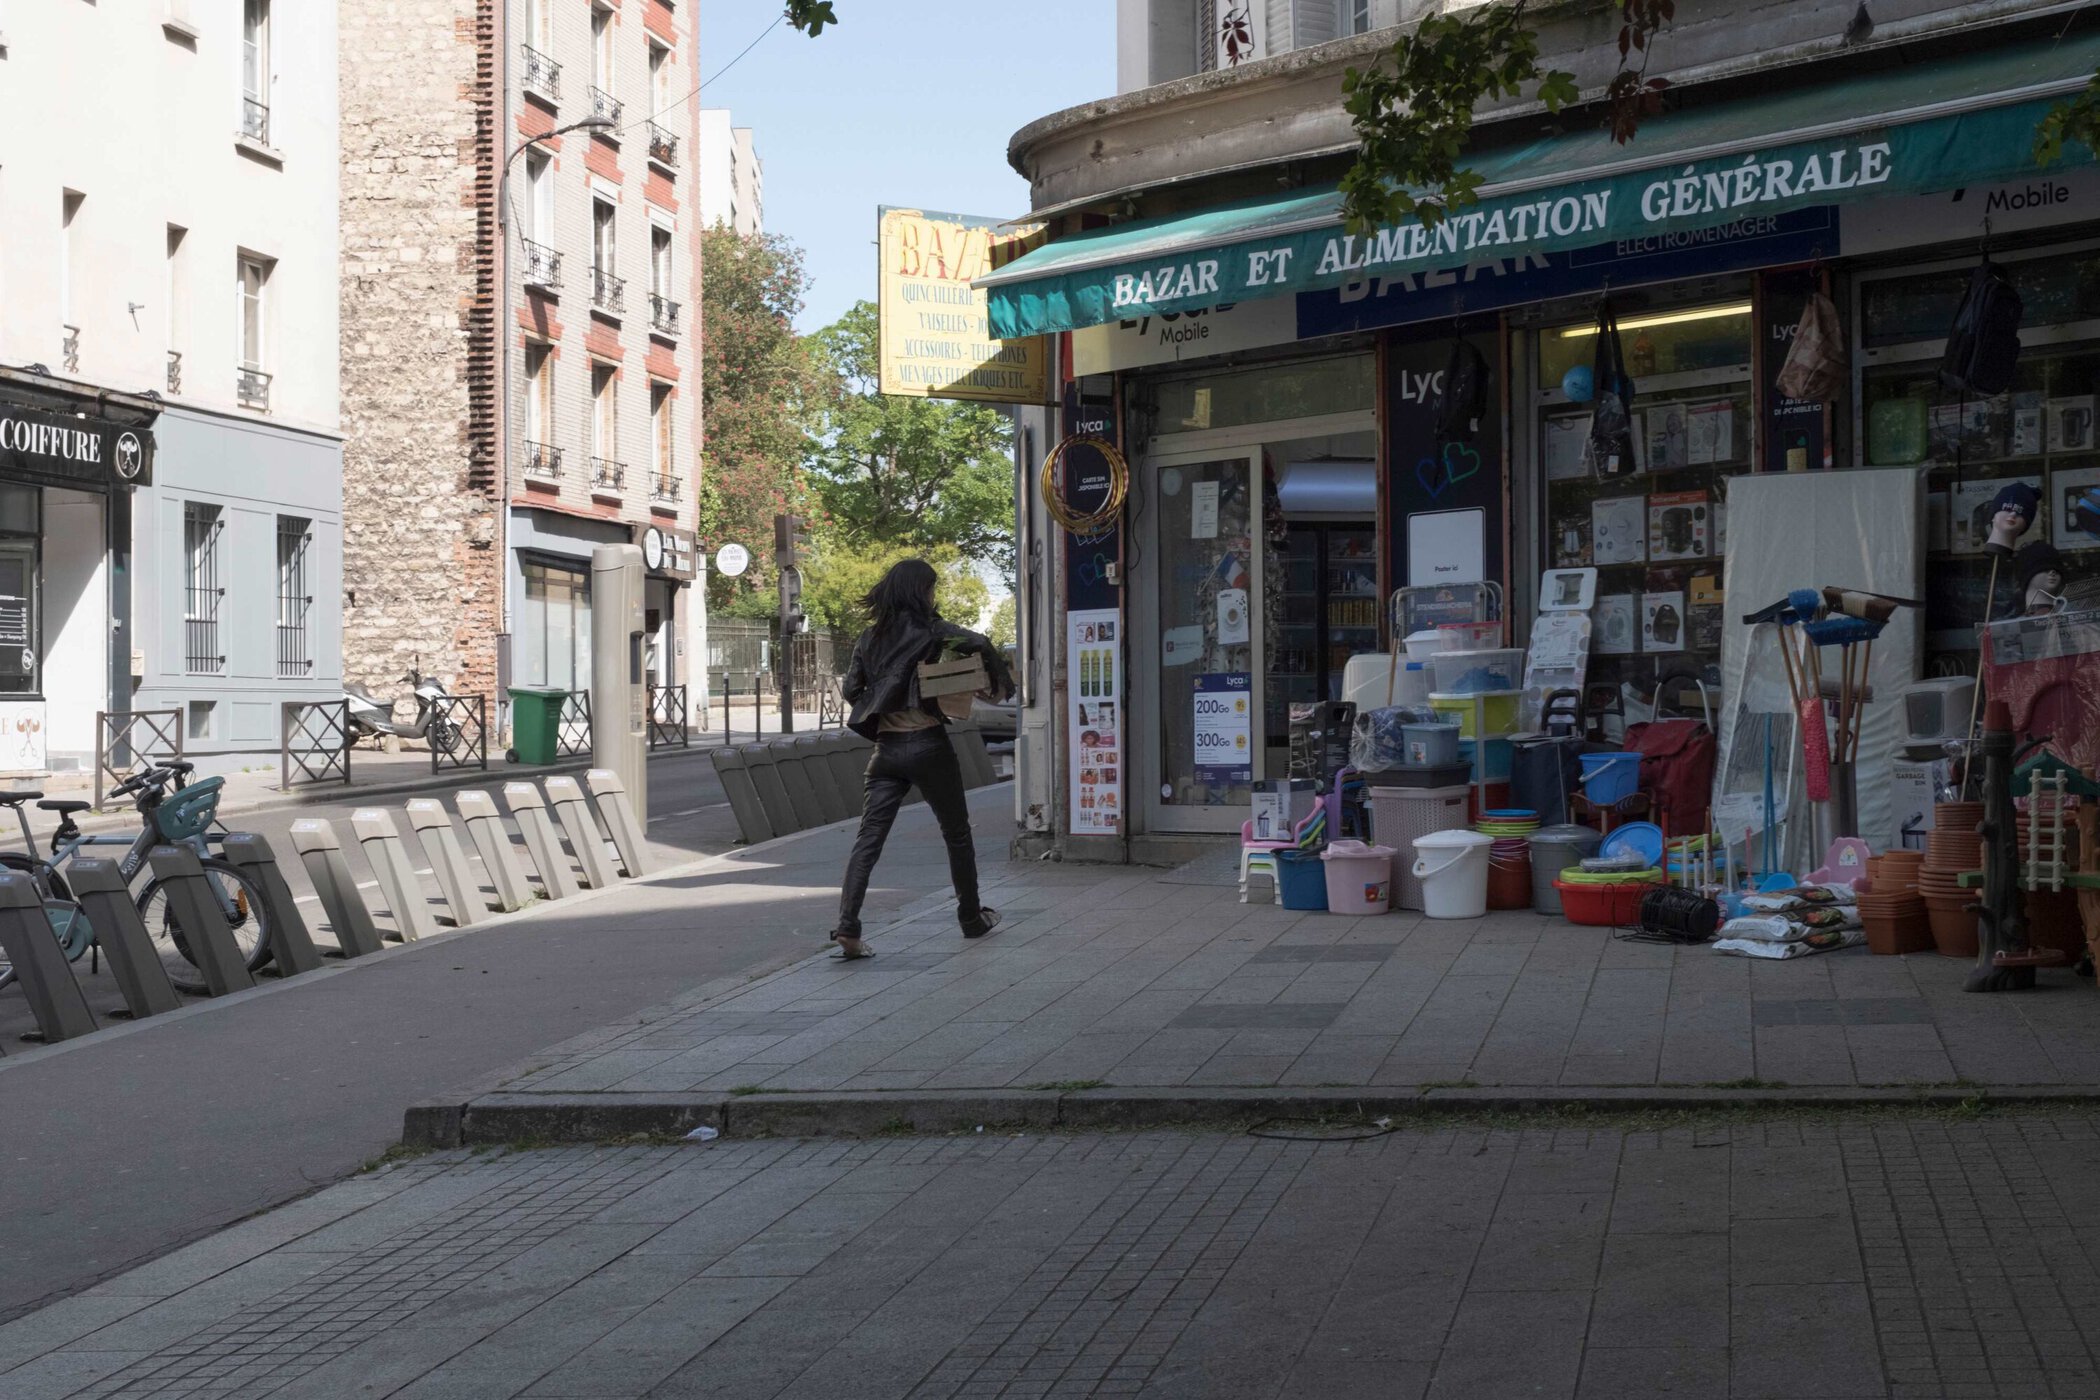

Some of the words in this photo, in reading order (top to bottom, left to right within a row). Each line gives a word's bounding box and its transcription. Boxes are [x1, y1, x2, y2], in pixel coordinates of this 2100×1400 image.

[1986, 182, 2069, 214] Mobile
[1112, 258, 1220, 308] BAZAR
[1246, 246, 1293, 287] ET
[1314, 188, 1612, 276] ALIMENTATION
[1641, 140, 1892, 223] GÉNÉRALE
[902, 282, 974, 306] QUINCAILLERIE
[919, 311, 967, 333] VAISELLES
[1160, 321, 1209, 345] Mobile
[904, 339, 961, 359] ACCESSOIRES
[970, 343, 1028, 364] TELEPHONES
[899, 363, 942, 384] MENAGES
[945, 367, 1006, 388] ELECTRIQUES
[0, 417, 101, 464] COIFFURE
[1226, 676, 1244, 687] Lyca
[1195, 699, 1230, 714] 200Go
[1195, 732, 1231, 748] 300Go
